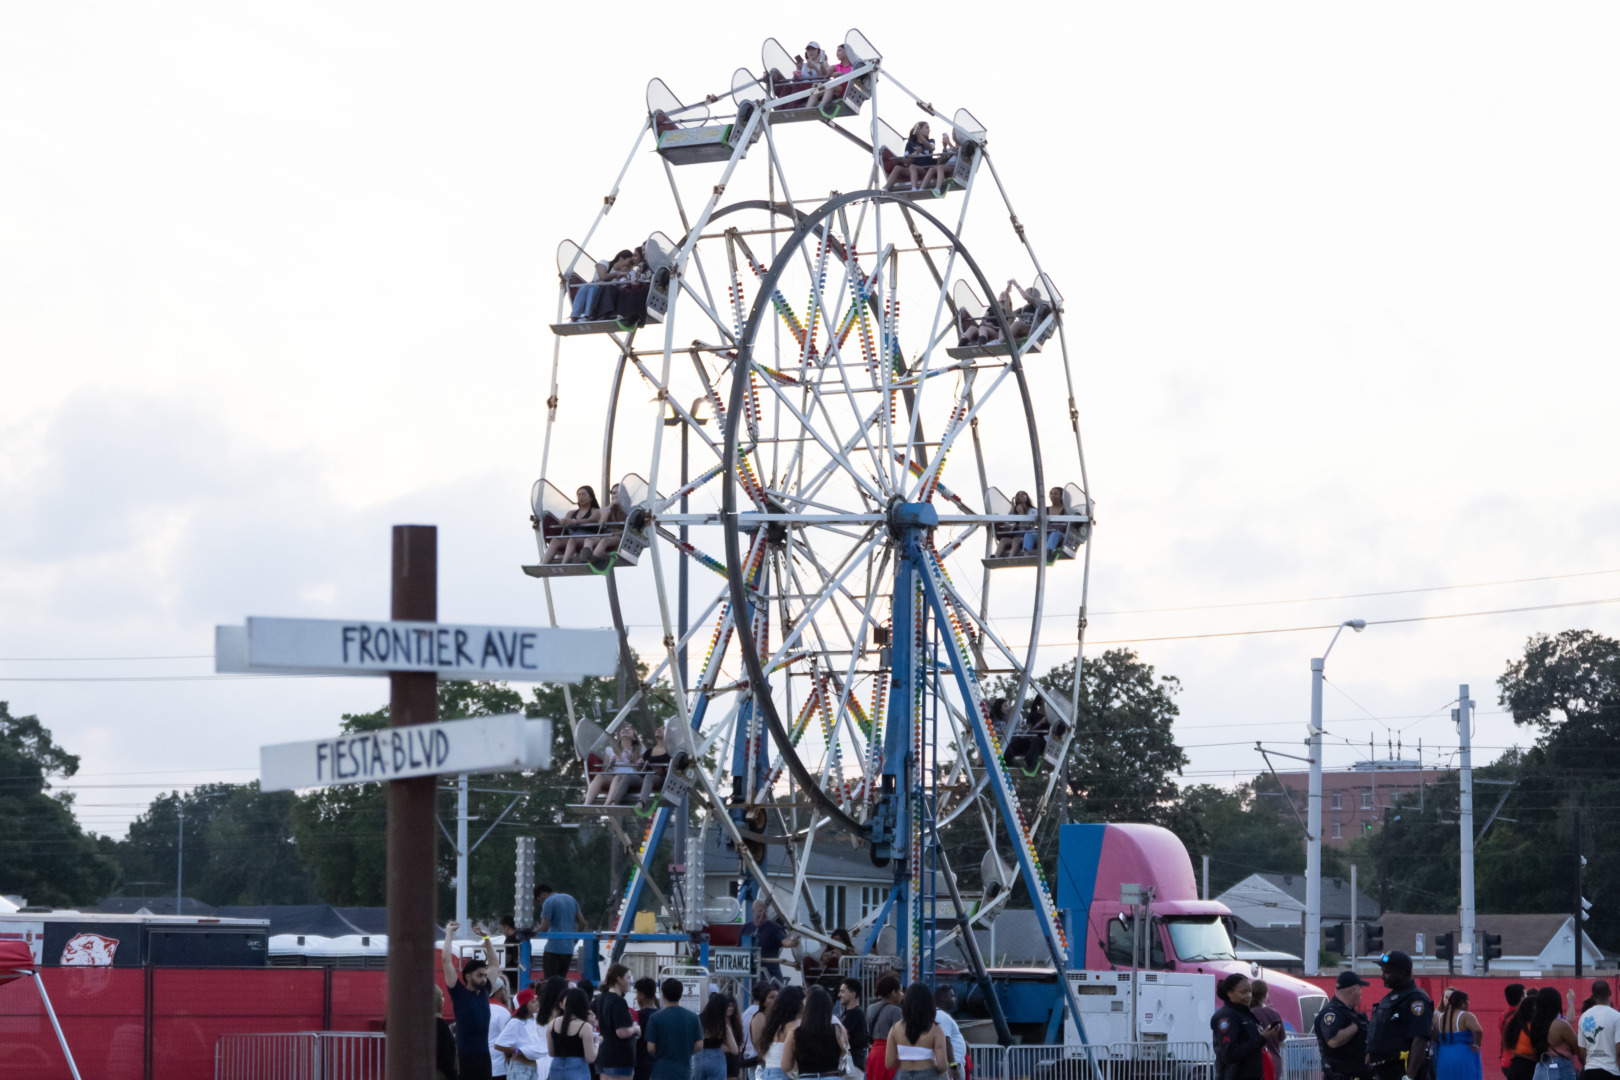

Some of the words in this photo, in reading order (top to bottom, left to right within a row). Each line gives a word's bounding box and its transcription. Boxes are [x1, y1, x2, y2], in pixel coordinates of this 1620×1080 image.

[342, 625, 474, 667] FRONTIER
[481, 630, 538, 669] AVE
[316, 734, 386, 781] FIESTA
[392, 729, 450, 774] BLVD
[715, 954, 750, 970] ENTRANCE
[688, 987, 693, 995] 5
